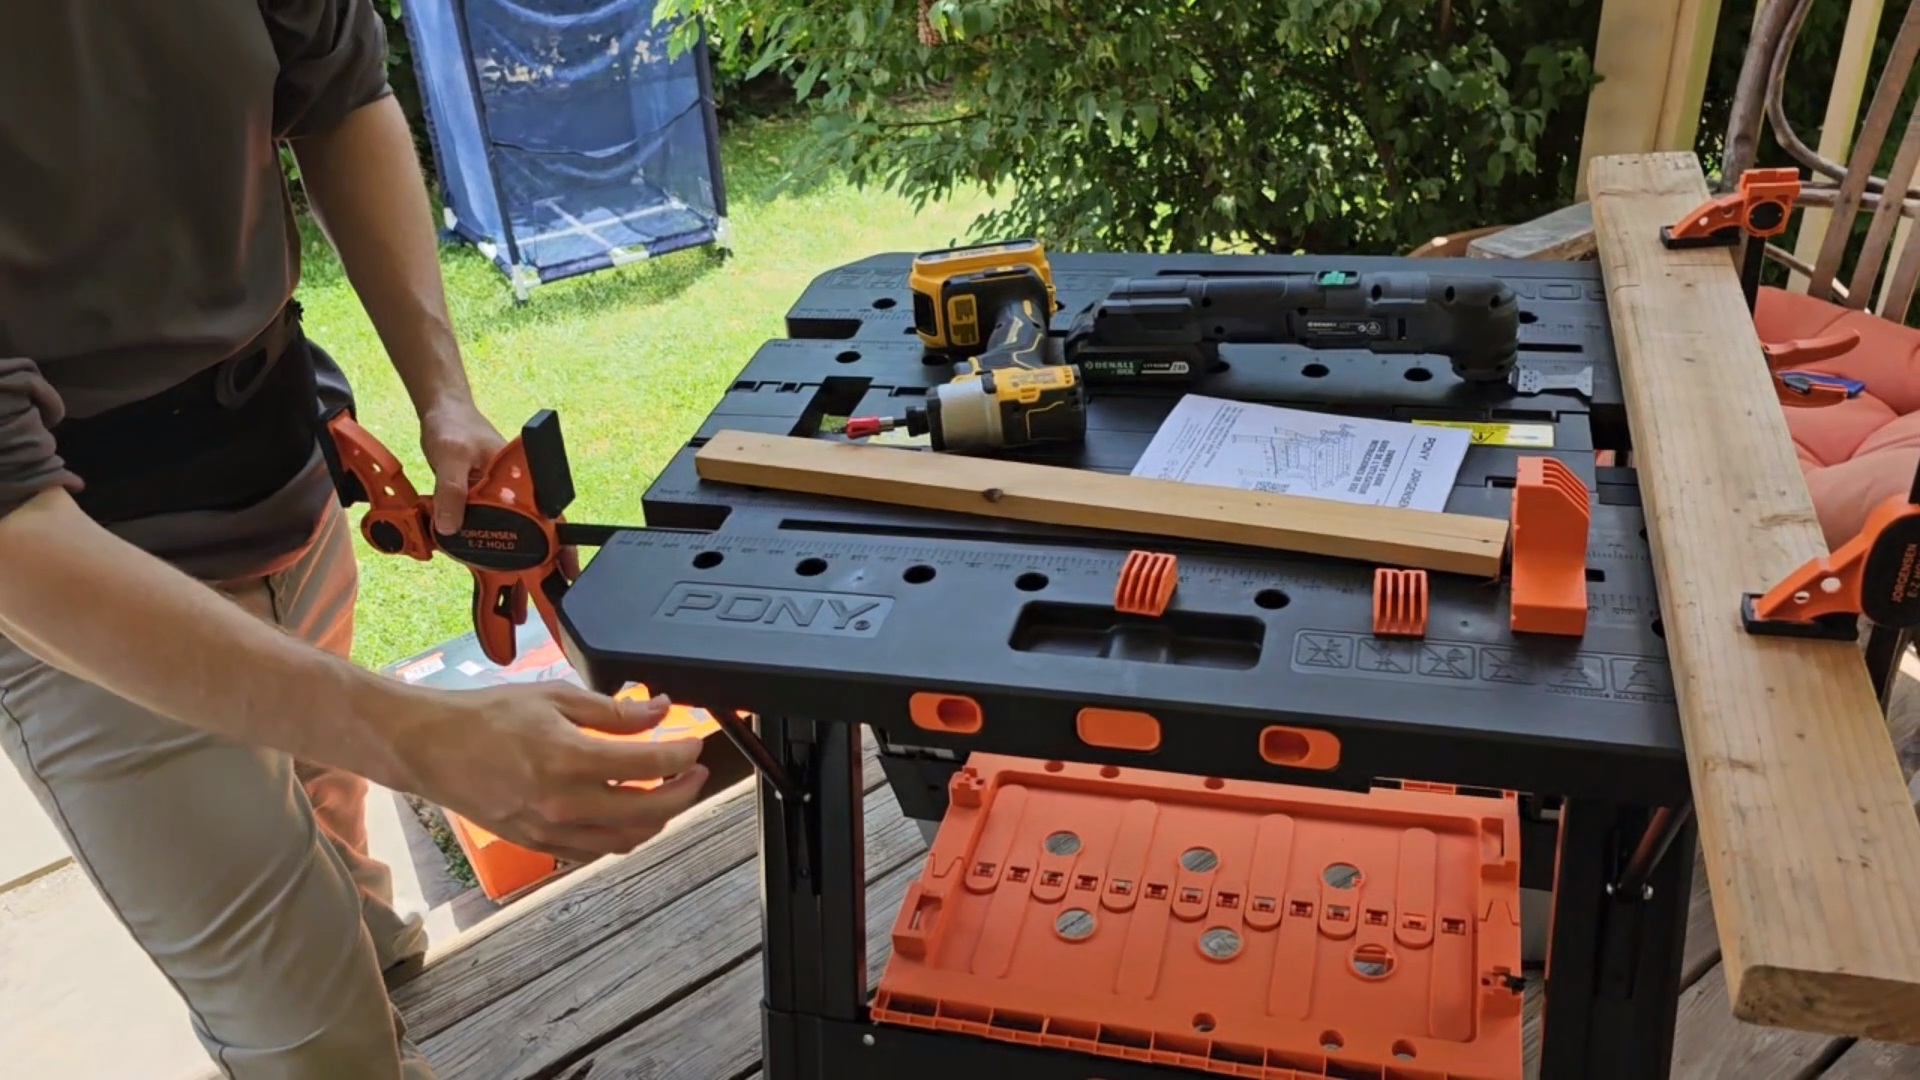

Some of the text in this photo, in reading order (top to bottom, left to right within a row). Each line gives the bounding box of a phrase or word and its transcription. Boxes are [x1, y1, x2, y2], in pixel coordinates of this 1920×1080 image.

[1418, 437, 1436, 461] PONY
[468, 540, 515, 550] E-Z HOLD
[1892, 544, 1918, 603] JORGENSEN
